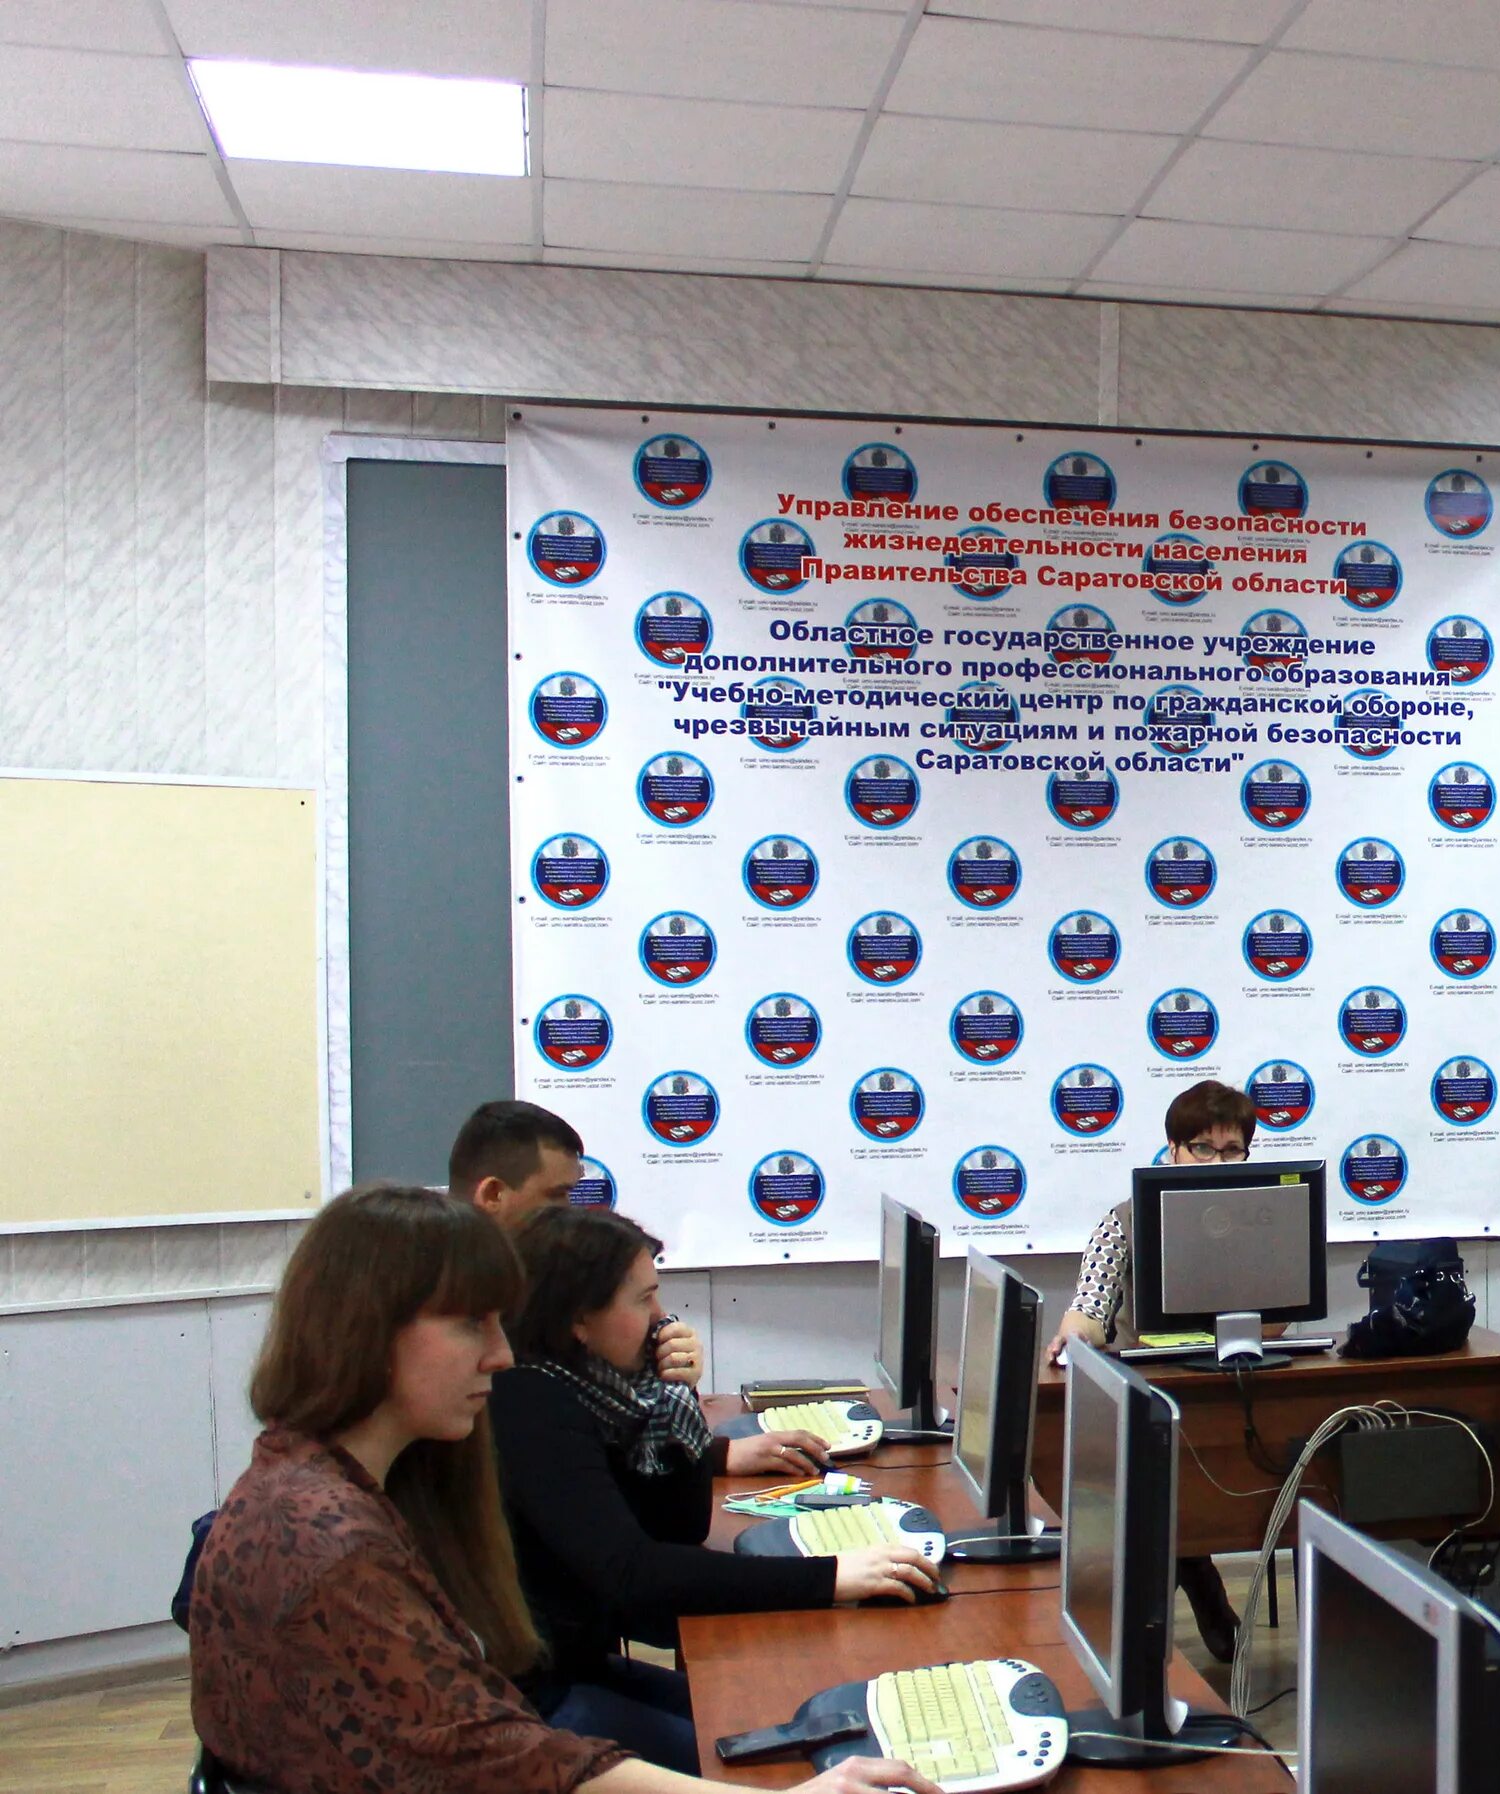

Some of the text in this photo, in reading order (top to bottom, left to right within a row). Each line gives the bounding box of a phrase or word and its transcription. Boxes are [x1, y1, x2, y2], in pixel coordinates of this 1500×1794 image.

[777, 494, 1366, 536] Управление обеспечения безопасности
[843, 533, 1307, 564] жизнедеятельности населения
[803, 558, 1346, 595] Правительства Саратовской области
[770, 620, 1376, 657] Областное государственное учреждение
[684, 653, 1451, 687] дополнительного профессионального образования
[658, 682, 1474, 720] "Учебно-методический центр по гражданской обороне,
[674, 717, 1462, 747] чрезвычайным ситуациям и пожарной безопасности
[916, 749, 1244, 773] Саратовской области"
